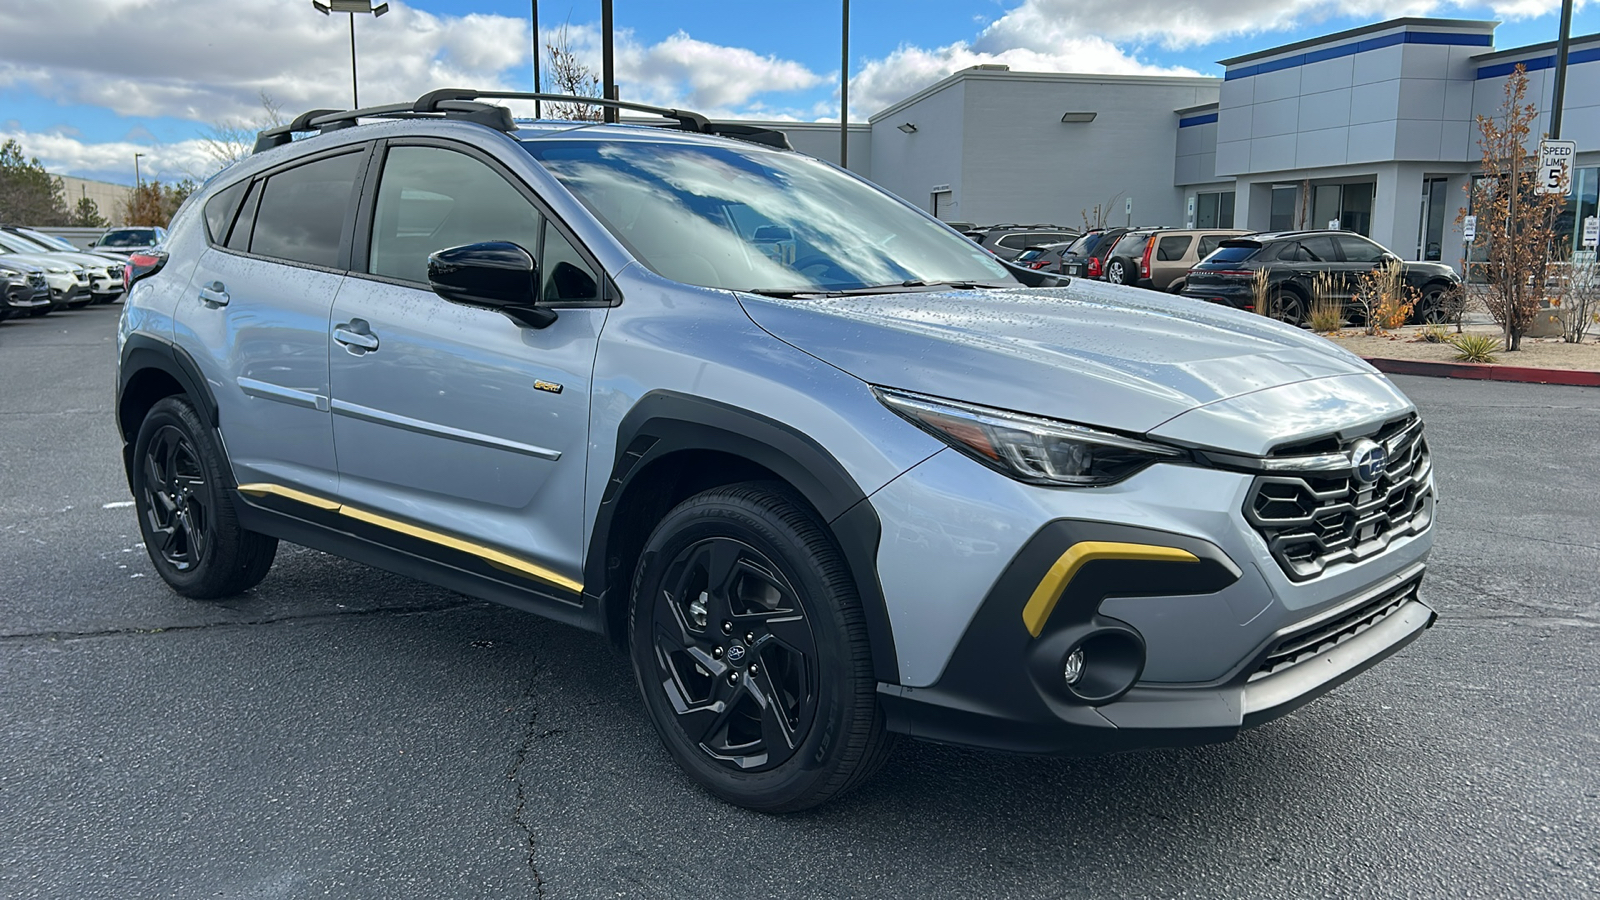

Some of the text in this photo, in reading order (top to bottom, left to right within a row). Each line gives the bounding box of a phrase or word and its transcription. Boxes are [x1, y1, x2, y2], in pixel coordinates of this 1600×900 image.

[1543, 146, 1571, 156] SPEED
[1545, 158, 1567, 167] LIMIT
[1547, 169, 1561, 189] 5
